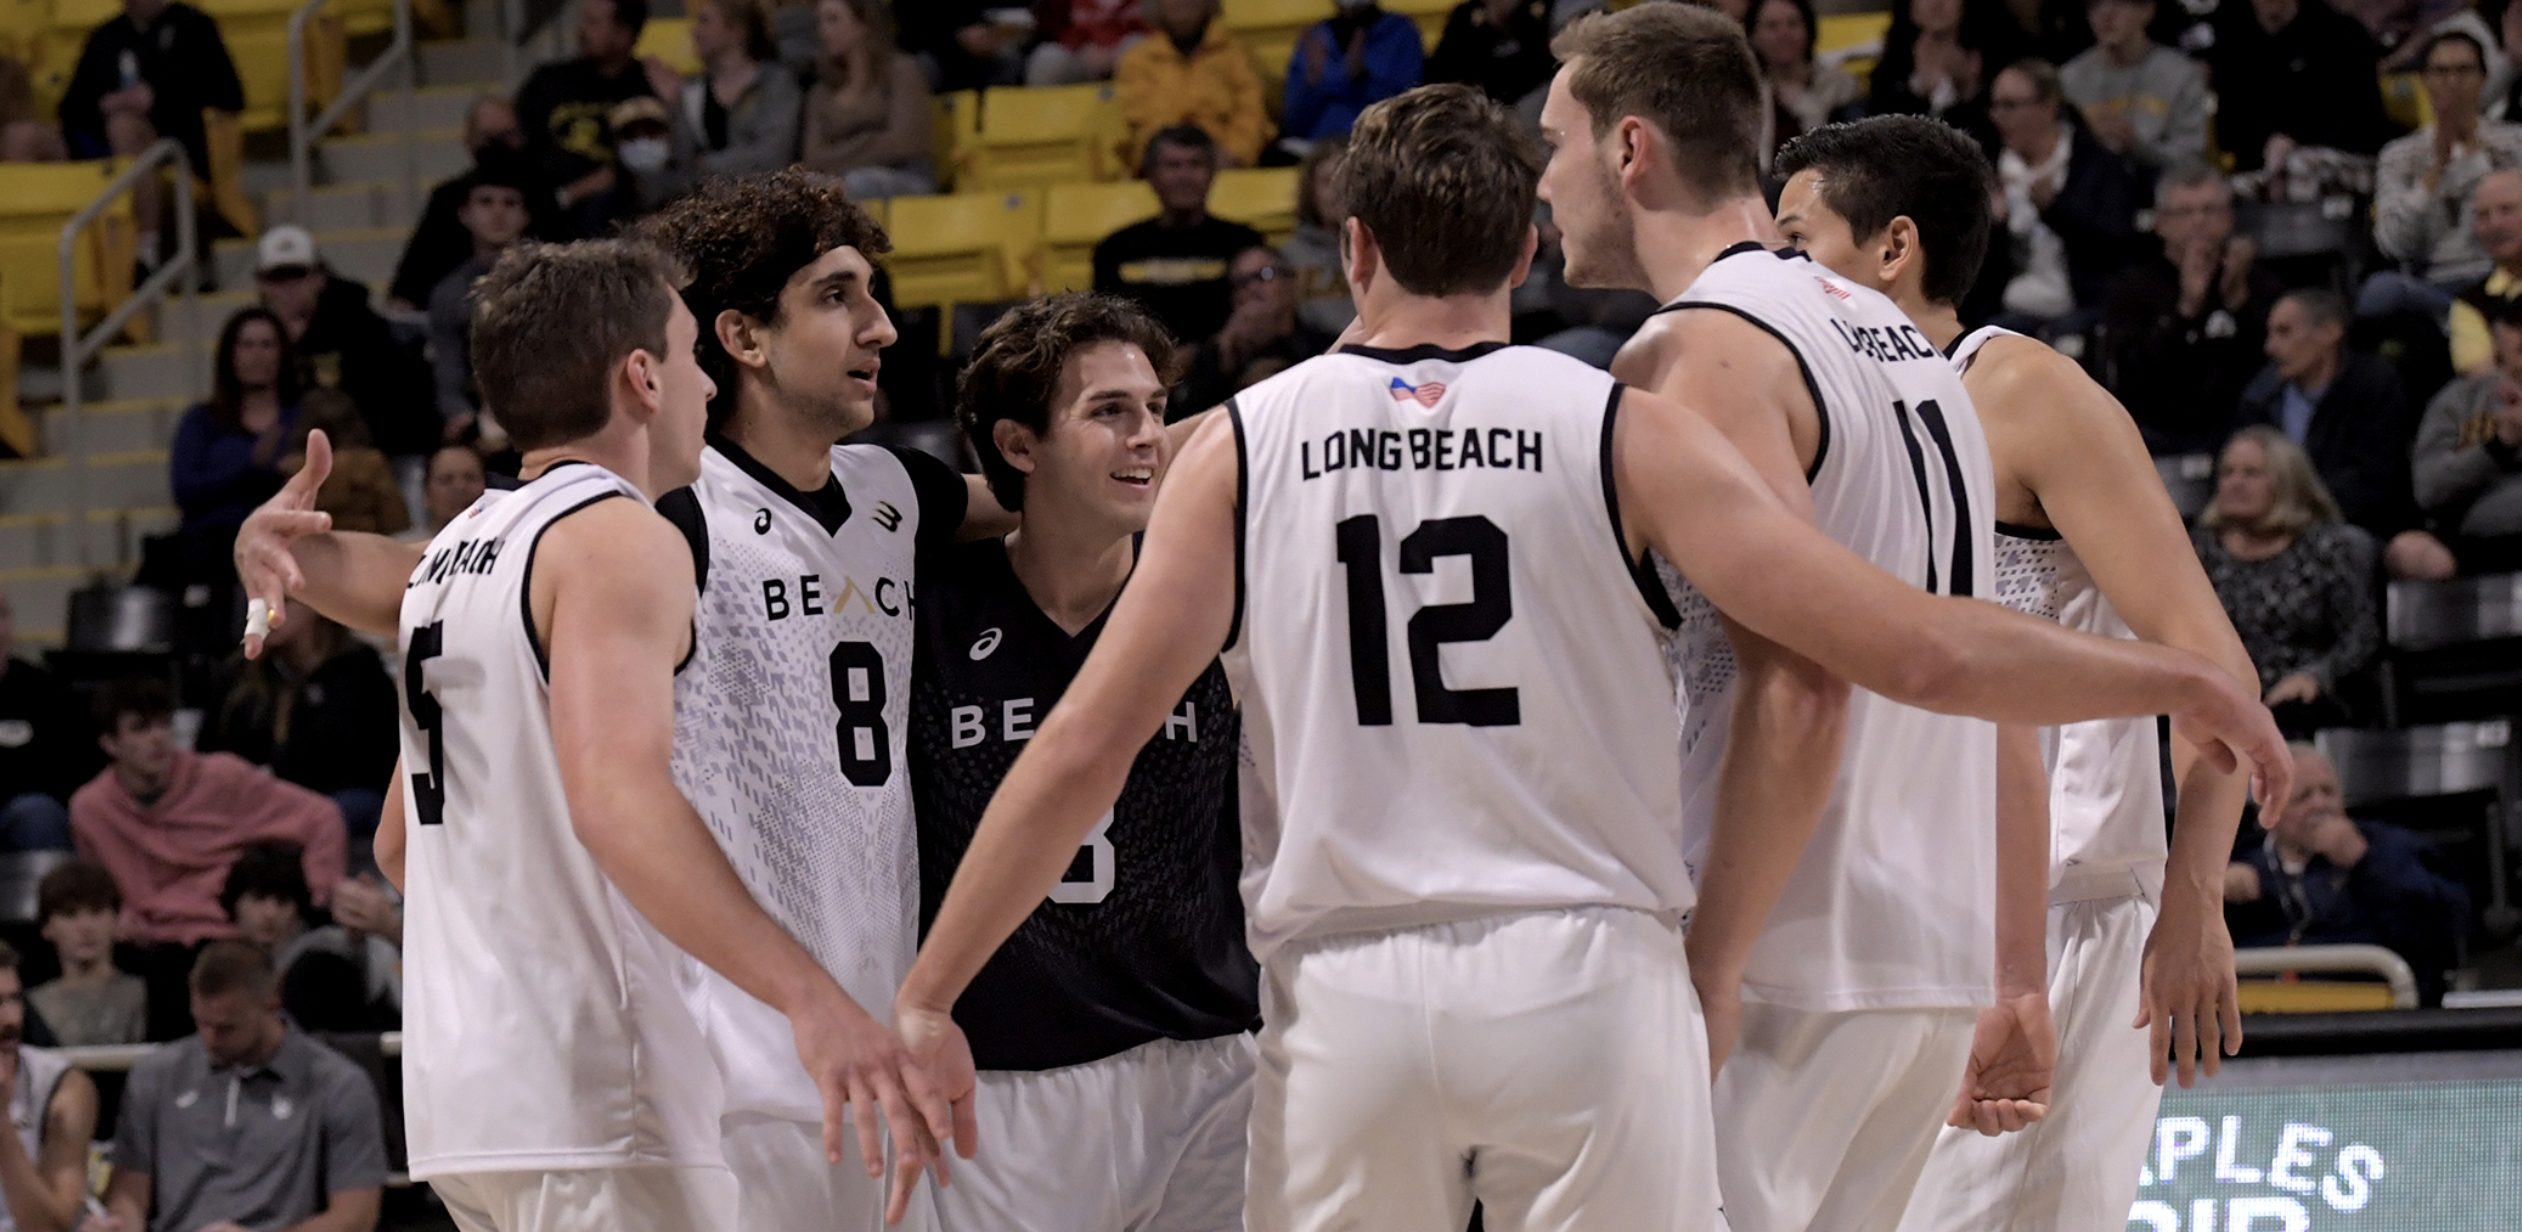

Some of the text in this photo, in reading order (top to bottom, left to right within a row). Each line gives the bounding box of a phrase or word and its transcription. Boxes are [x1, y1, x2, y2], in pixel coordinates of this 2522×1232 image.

[1302, 427, 1543, 481] LONG BEACH
[1892, 399, 1973, 596] 11
[1336, 514, 1521, 727] 12
[405, 619, 445, 825] 5
[829, 641, 893, 787] 8
[951, 697, 1198, 750] BEH
[2139, 1114, 2385, 1214] PLES
